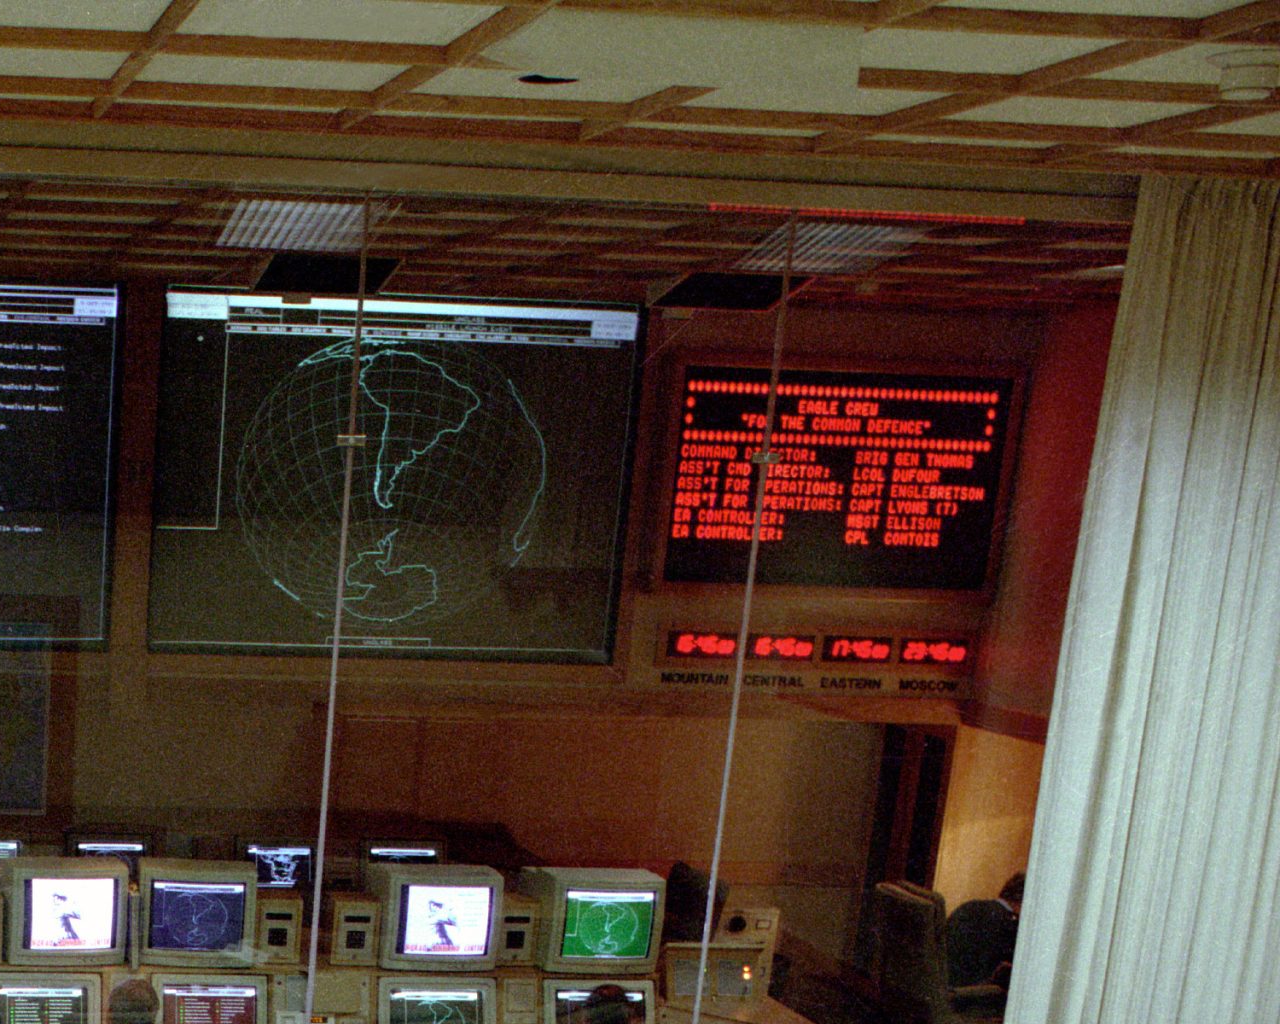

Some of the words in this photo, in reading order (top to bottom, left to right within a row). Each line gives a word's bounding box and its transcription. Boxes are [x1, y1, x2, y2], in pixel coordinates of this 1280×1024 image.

[798, 400, 839, 415] EAGLE
[845, 401, 879, 416] CREW
[781, 415, 804, 430] THE
[812, 417, 861, 432] COMMON
[681, 444, 737, 459] COMMAND
[895, 452, 919, 466] GEN
[679, 461, 719, 475] ASS'T
[761, 464, 830, 479] IRECTOR:
[853, 467, 885, 482] LCOL
[892, 468, 940, 483] DUFOUR
[677, 477, 718, 491] ASS'T
[725, 478, 750, 492] FOR
[758, 480, 844, 495] PERATIONS:
[852, 482, 884, 497] CAPT
[723, 494, 748, 508] FOR
[756, 496, 842, 512] PERATIONS:
[849, 499, 881, 513] CAPT
[673, 508, 691, 522] EA
[887, 516, 941, 530] ELLISON
[672, 524, 689, 539] EA
[845, 530, 868, 545] CPL
[884, 532, 939, 547] CONTOIS
[661, 672, 729, 684] MOUNTAIN
[744, 675, 804, 687] CENTRAL
[821, 677, 881, 688] EASTERN
[899, 679, 957, 691] MOSCOW
